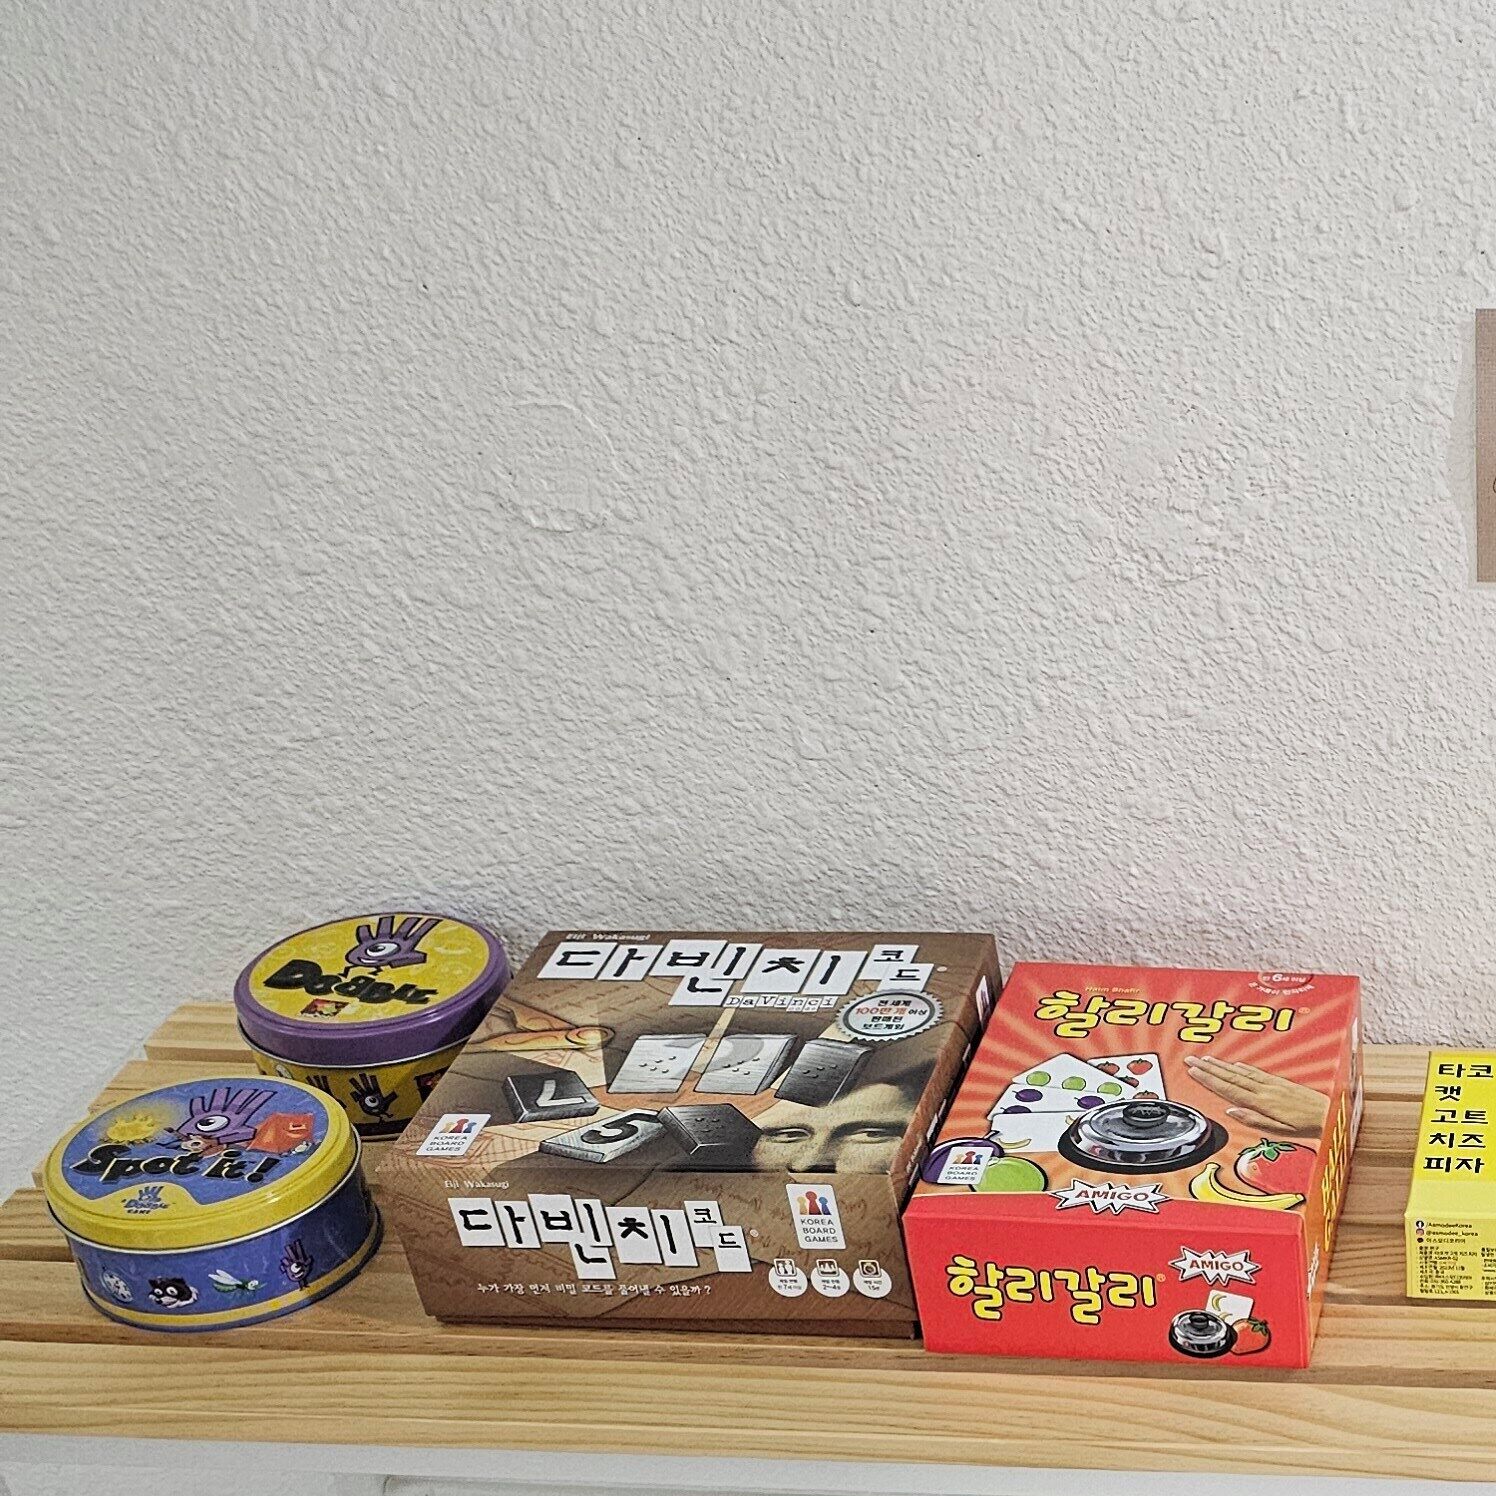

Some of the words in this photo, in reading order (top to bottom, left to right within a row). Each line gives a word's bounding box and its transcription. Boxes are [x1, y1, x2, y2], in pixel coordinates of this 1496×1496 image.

[1034, 989, 1298, 1044] 할리갈리
[1437, 1063, 1495, 1079] 타코
[1434, 1084, 1462, 1102] 캣
[1430, 1108, 1489, 1125] 고트
[1428, 1132, 1487, 1149] 치즈
[70, 1143, 204, 1184] Spot
[201, 1149, 281, 1184] it!
[1423, 1156, 1486, 1174] 피자
[1074, 1188, 1150, 1202] AMIGO
[800, 1218, 835, 1226] KOREA
[802, 1227, 837, 1235] BOARD
[1188, 1259, 1245, 1272] AMIGO
[477, 1282, 500, 1294] 누가
[503, 1282, 525, 1295] 가장
[554, 1283, 577, 1295] 비밀
[653, 1284, 666, 1295] 수
[945, 1254, 1158, 1326] 할리갈리
